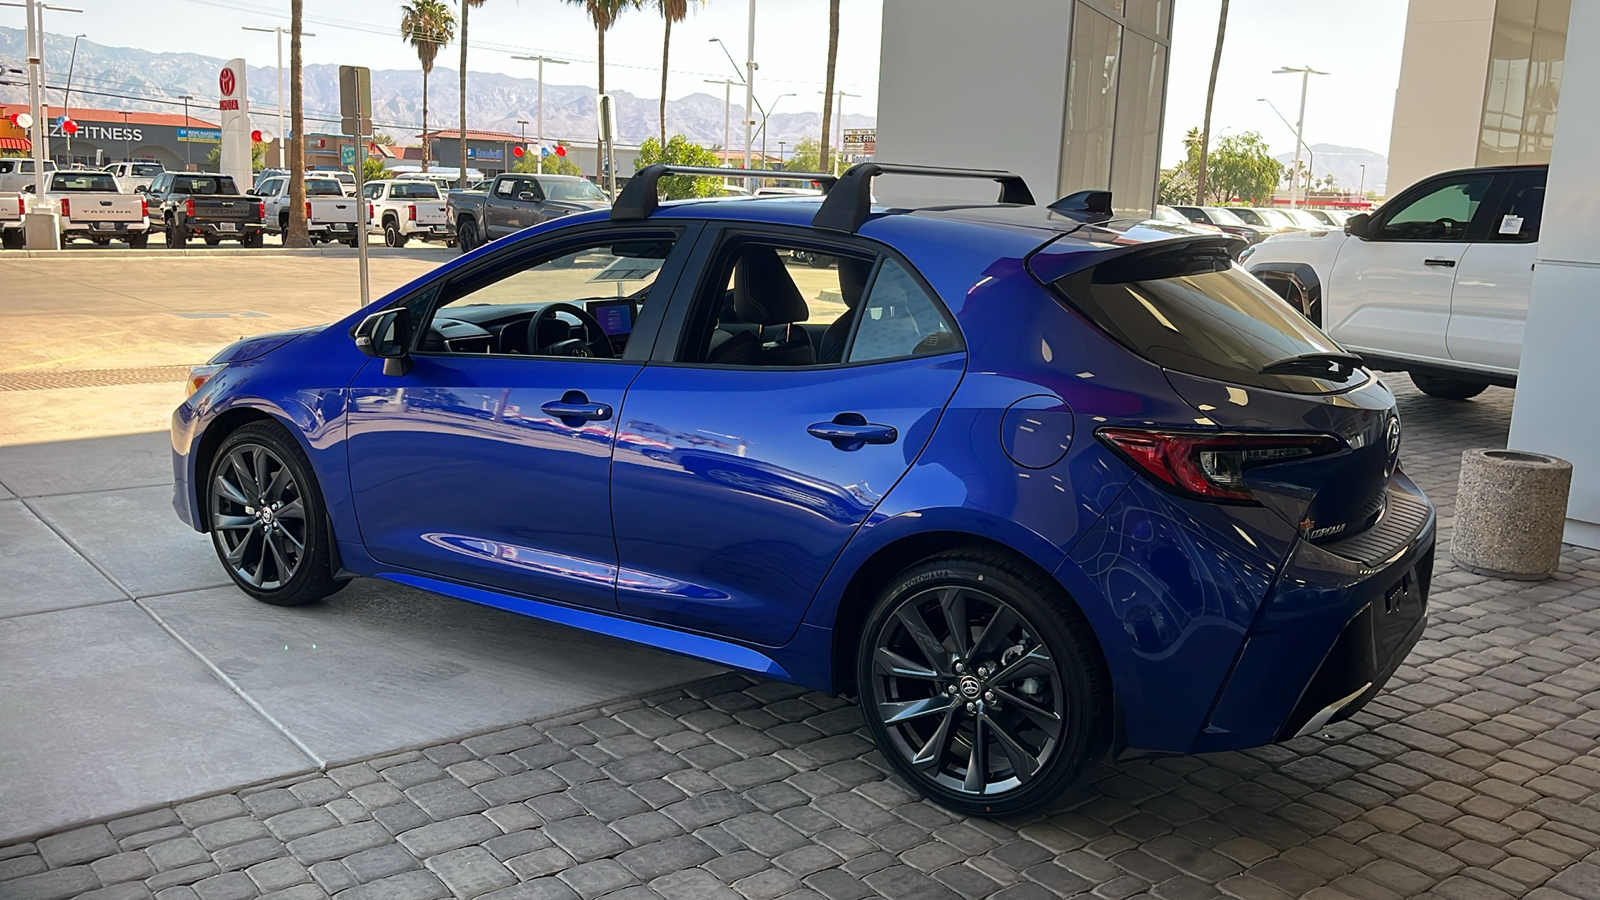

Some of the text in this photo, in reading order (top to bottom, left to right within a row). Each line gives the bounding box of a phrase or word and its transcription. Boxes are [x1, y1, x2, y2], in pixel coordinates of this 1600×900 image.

[74, 126, 143, 141] FITNESS
[1310, 523, 1347, 539] COROLLA
[903, 570, 949, 588] YOKOHAMA
